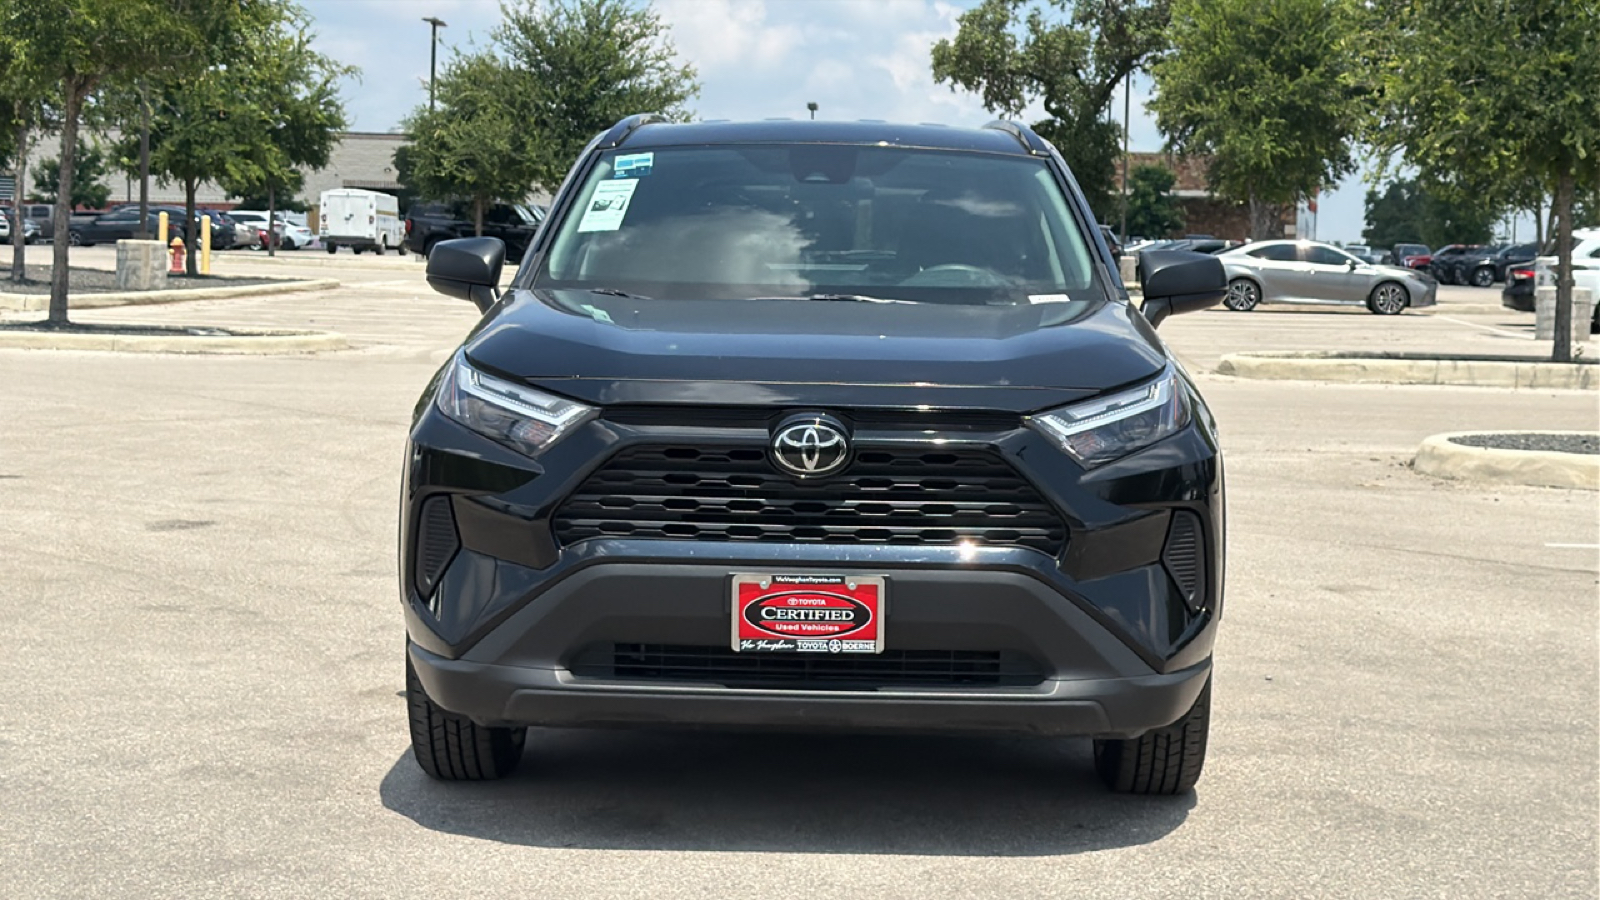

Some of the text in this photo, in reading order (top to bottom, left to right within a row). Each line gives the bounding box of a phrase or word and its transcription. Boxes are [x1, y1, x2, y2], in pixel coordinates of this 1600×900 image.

[760, 606, 855, 621] CERTIFIED
[797, 641, 875, 650] TOYOTA BOERNE
